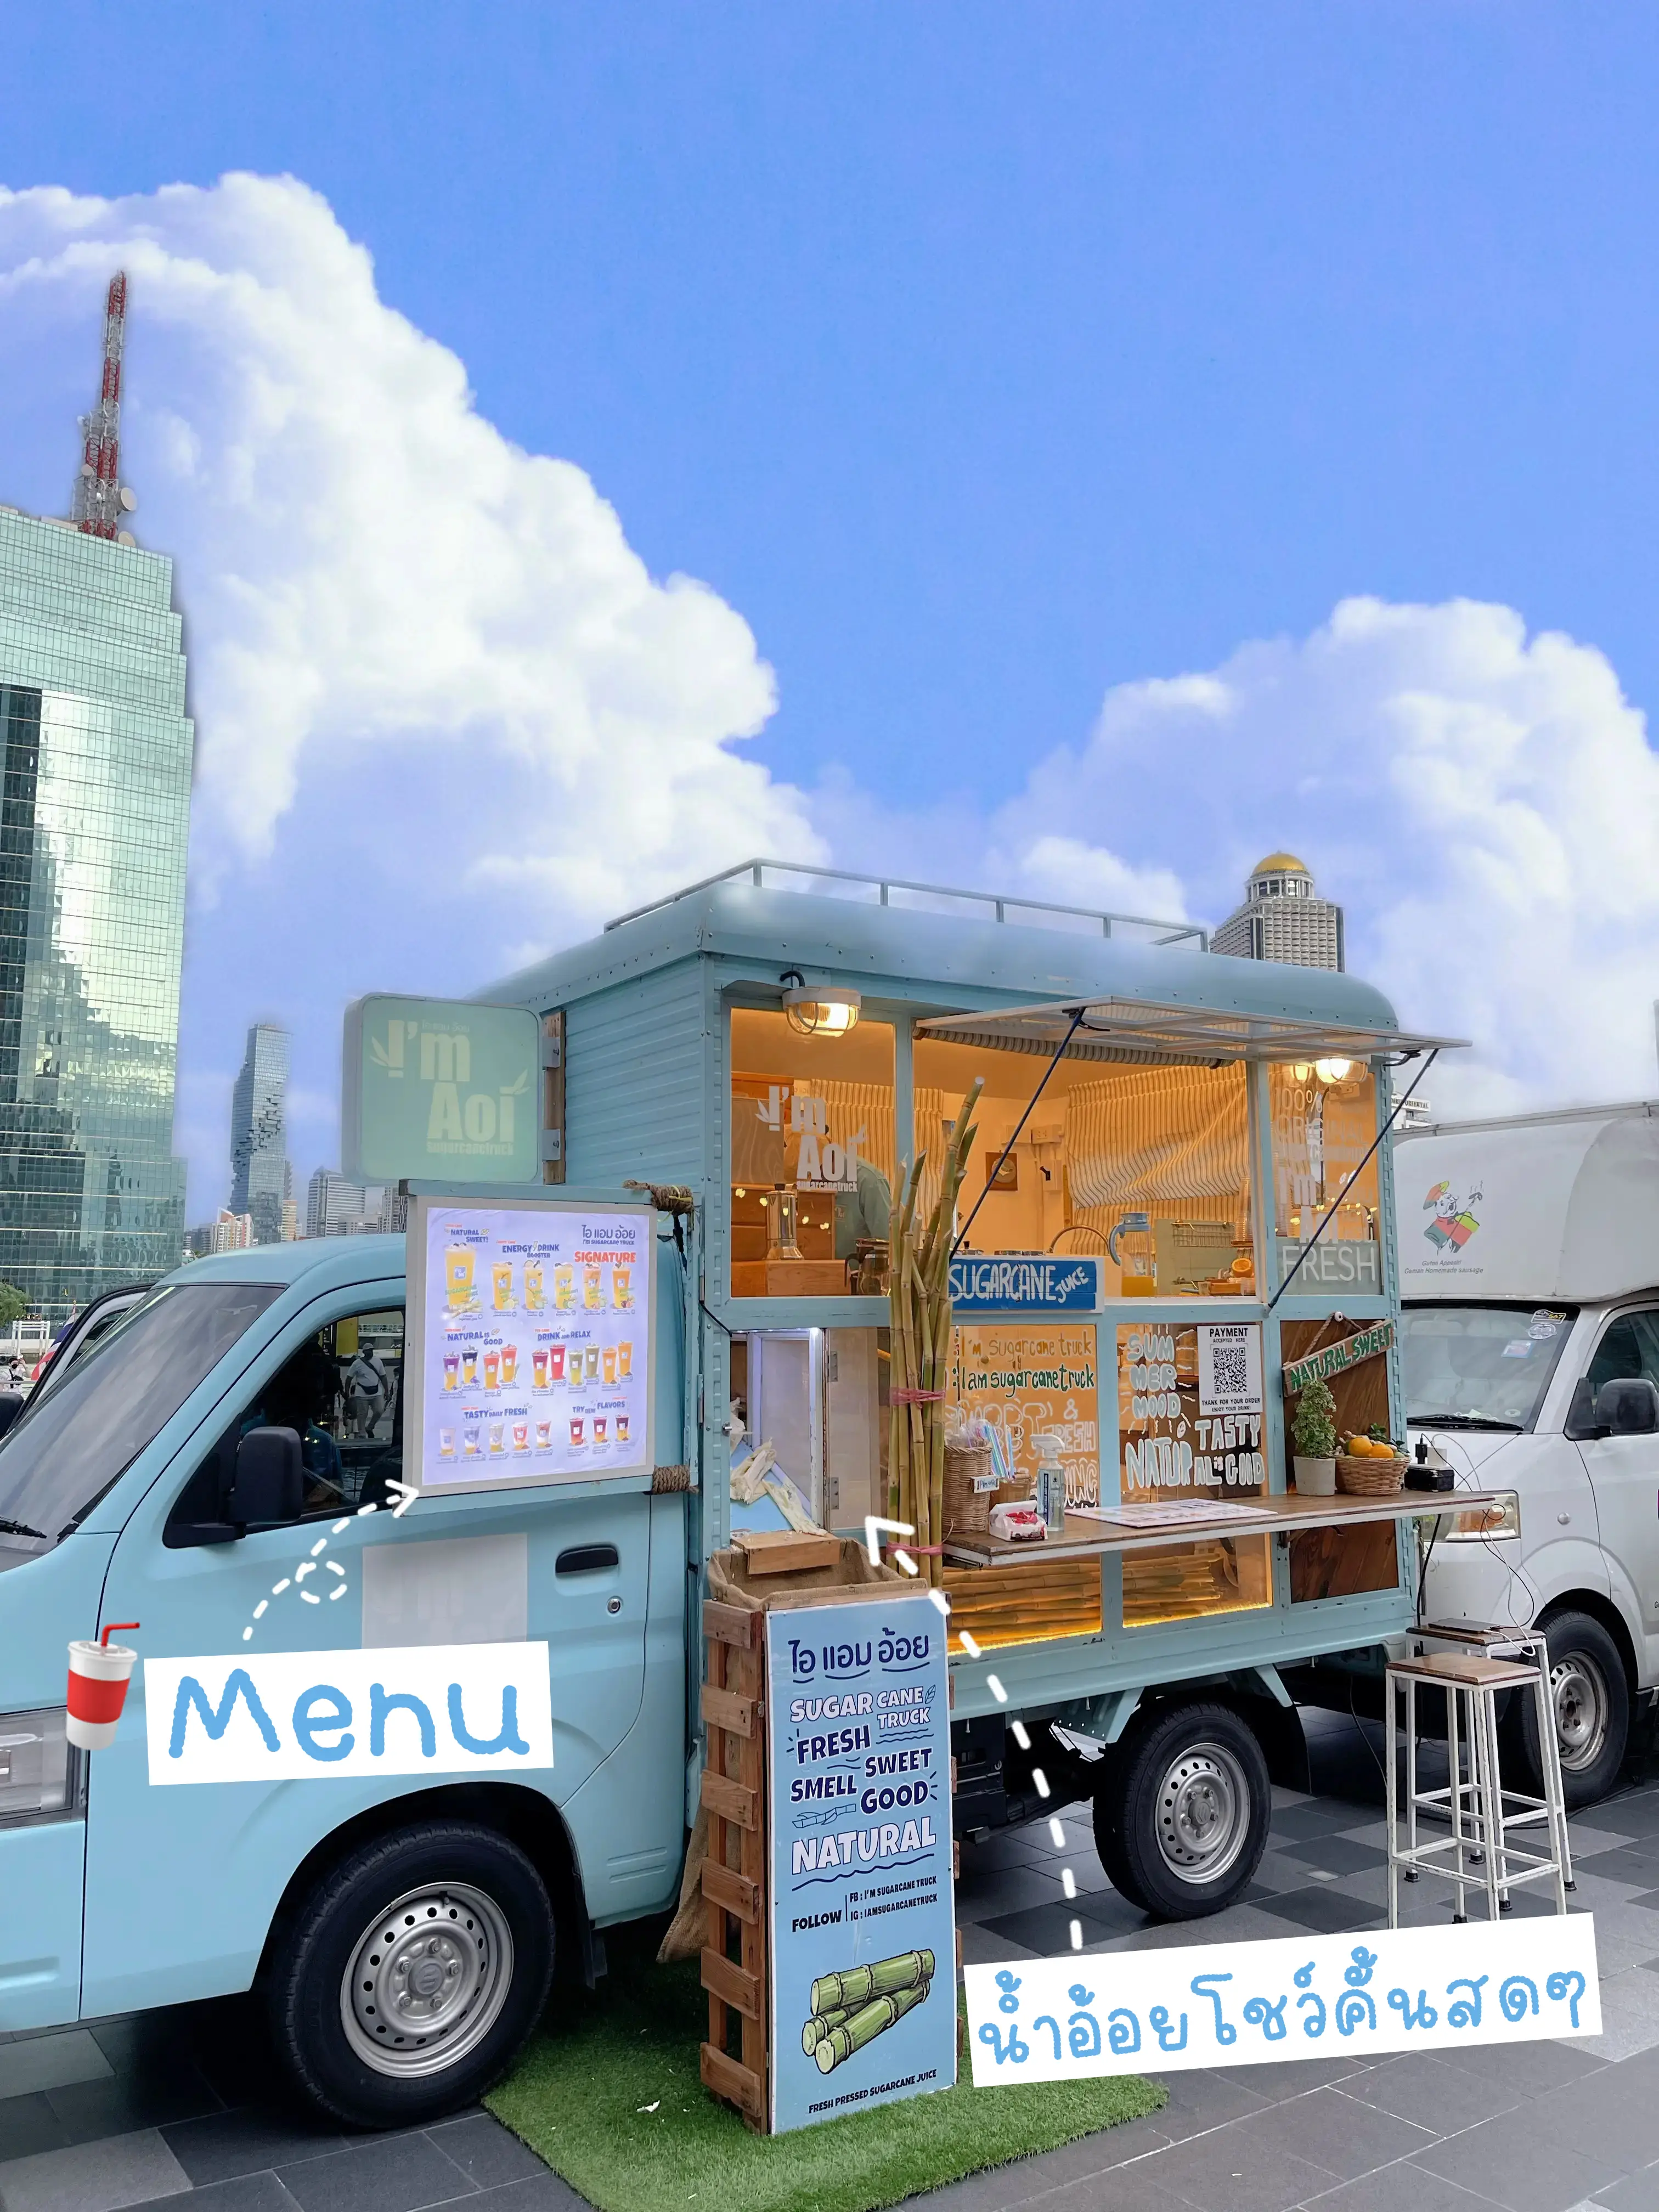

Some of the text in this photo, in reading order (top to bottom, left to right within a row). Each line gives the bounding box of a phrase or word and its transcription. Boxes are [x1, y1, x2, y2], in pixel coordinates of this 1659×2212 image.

[582, 1224, 636, 1239] ไอ แอม อ้อย
[501, 1244, 560, 1254] ENERGY DRINK
[574, 1251, 636, 1263] SIGNATURE
[1282, 1245, 1375, 1282] FRESH
[948, 1262, 1057, 1302] SUGARCANE
[447, 1330, 483, 1341] NATURAL
[537, 1331, 561, 1341] DRINK
[570, 1330, 591, 1339] RELAX
[989, 1339, 1054, 1362] sugarcane
[1058, 1331, 1092, 1356] truck
[1210, 1328, 1248, 1337] PAYMENT
[1290, 1322, 1394, 1393] NATURAL SWEET
[464, 1410, 489, 1419] TASTY
[504, 1407, 528, 1417] FRESH
[597, 1400, 625, 1410] FLAVORS
[1131, 1392, 1181, 1419] MOOD
[1194, 1414, 1261, 1451] TASTY
[788, 1627, 929, 1674] ไอ แอม อ้อย
[790, 1686, 924, 1723] SUGAR CANE
[876, 1706, 931, 1729] TRUCK
[797, 1724, 871, 1766] FRESH
[864, 1748, 933, 1779] SWEET
[790, 1774, 857, 1803] SMELL
[860, 1780, 929, 1815] GOOD
[792, 1816, 936, 1875] NATURAL
[864, 1888, 876, 1900] I'M
[877, 1880, 916, 1897] SUGARCANE
[916, 1875, 937, 1887] TRUCK
[792, 1910, 842, 1933] FOLLOW
[809, 2068, 938, 2114] FRESH PRESSED SUGARCANE JUICE
